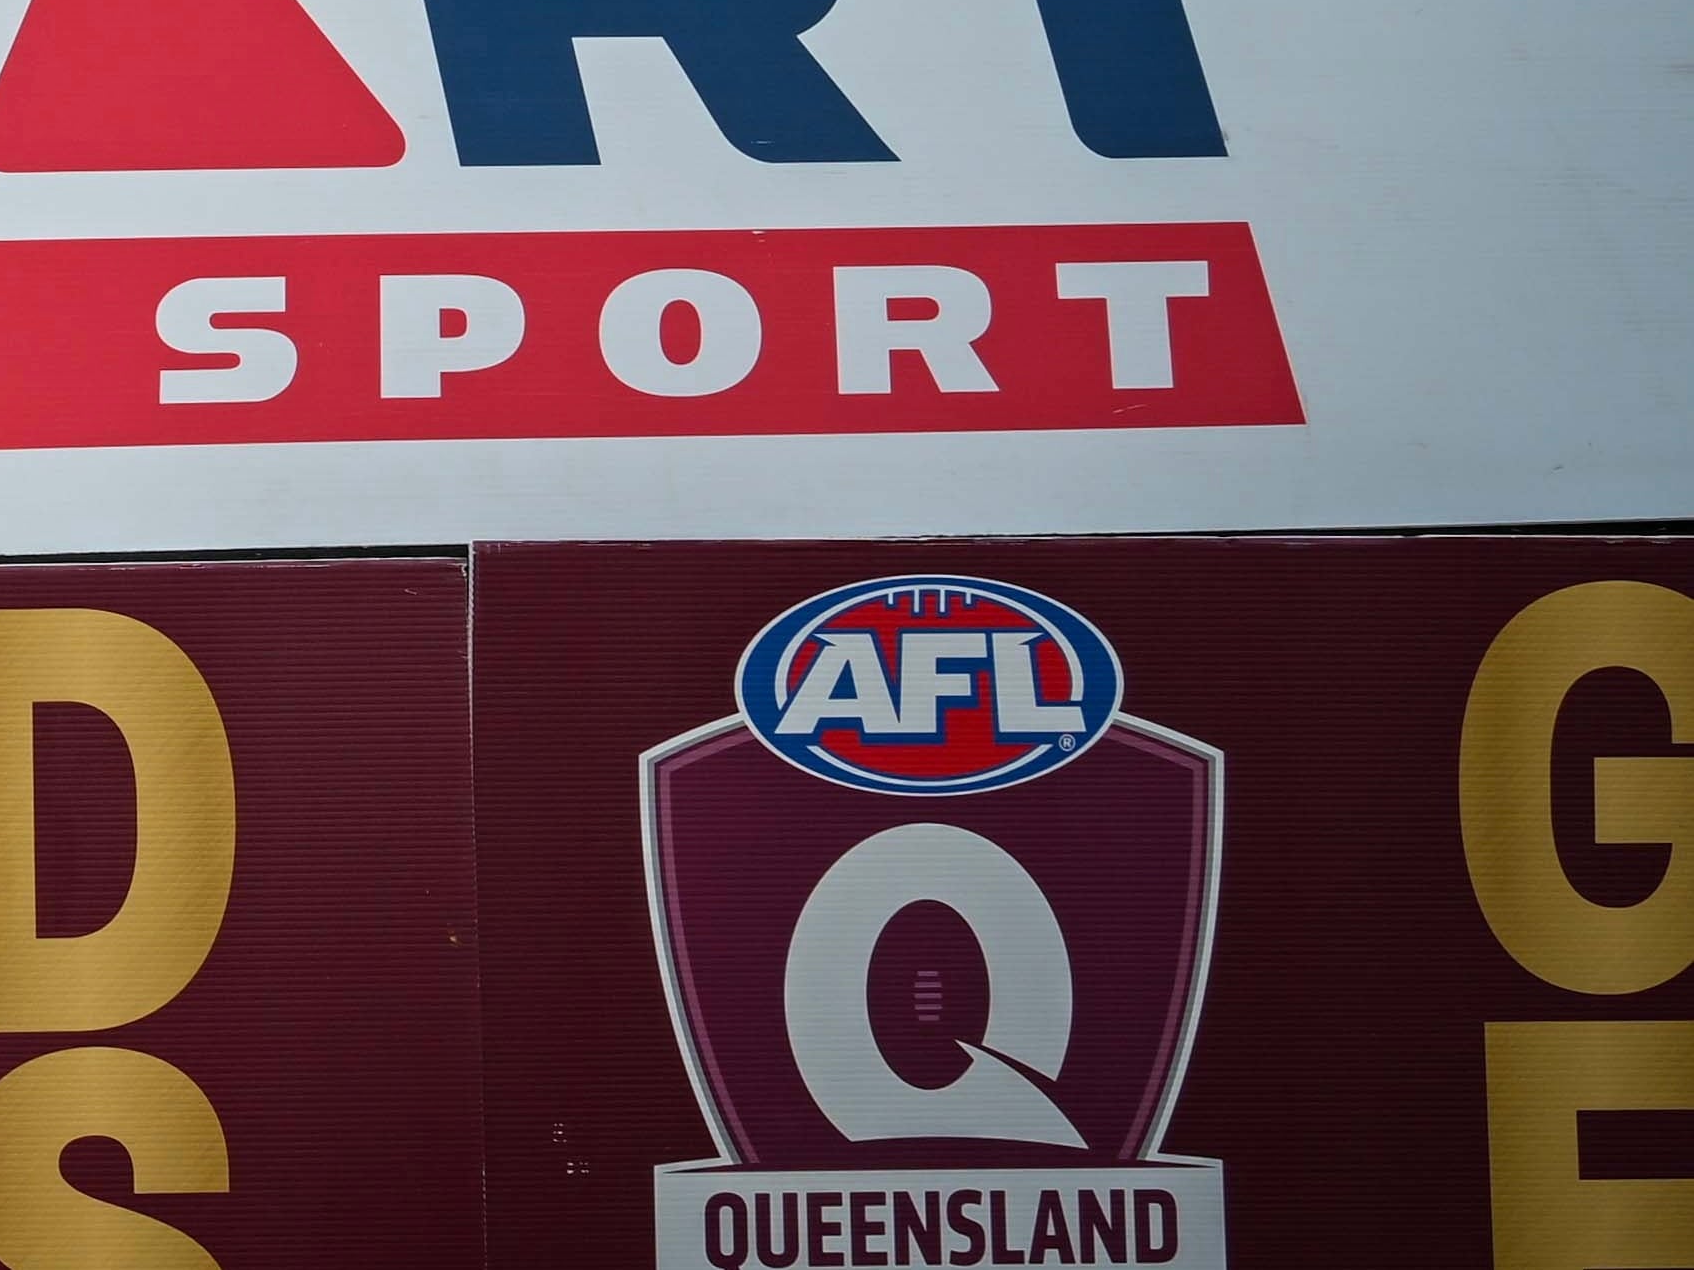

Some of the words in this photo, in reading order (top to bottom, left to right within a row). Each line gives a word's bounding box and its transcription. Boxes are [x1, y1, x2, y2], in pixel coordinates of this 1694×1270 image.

[153, 259, 1211, 408] SPORT
[774, 631, 1070, 746] AFL
[782, 819, 1089, 1149] Q
[703, 1187, 1181, 1270] QUEENSLAND
